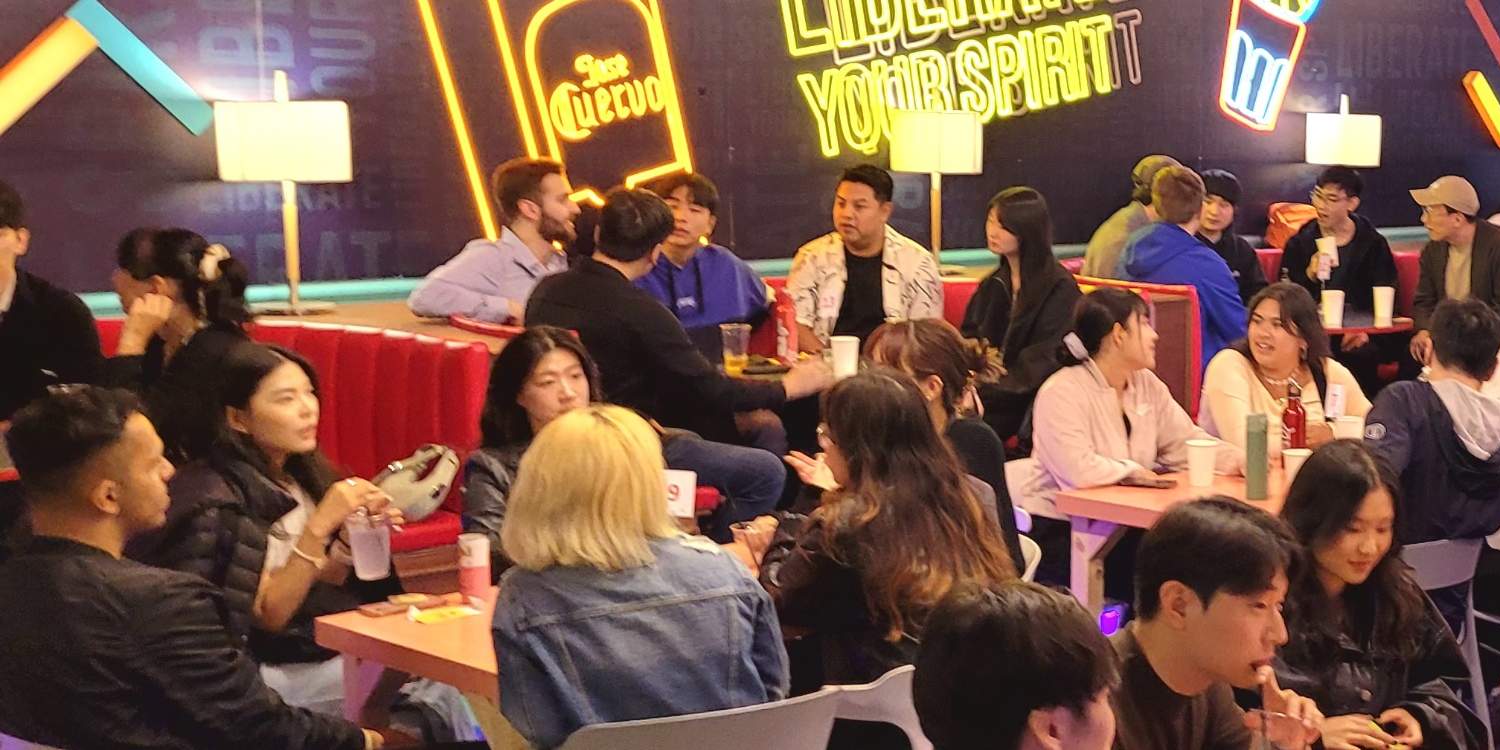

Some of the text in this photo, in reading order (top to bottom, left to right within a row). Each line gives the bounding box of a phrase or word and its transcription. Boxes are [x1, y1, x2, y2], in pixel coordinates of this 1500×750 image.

[952, 14, 1113, 126] SPIRIT
[549, 75, 666, 140] Cuervo
[667, 483, 680, 502] 9
